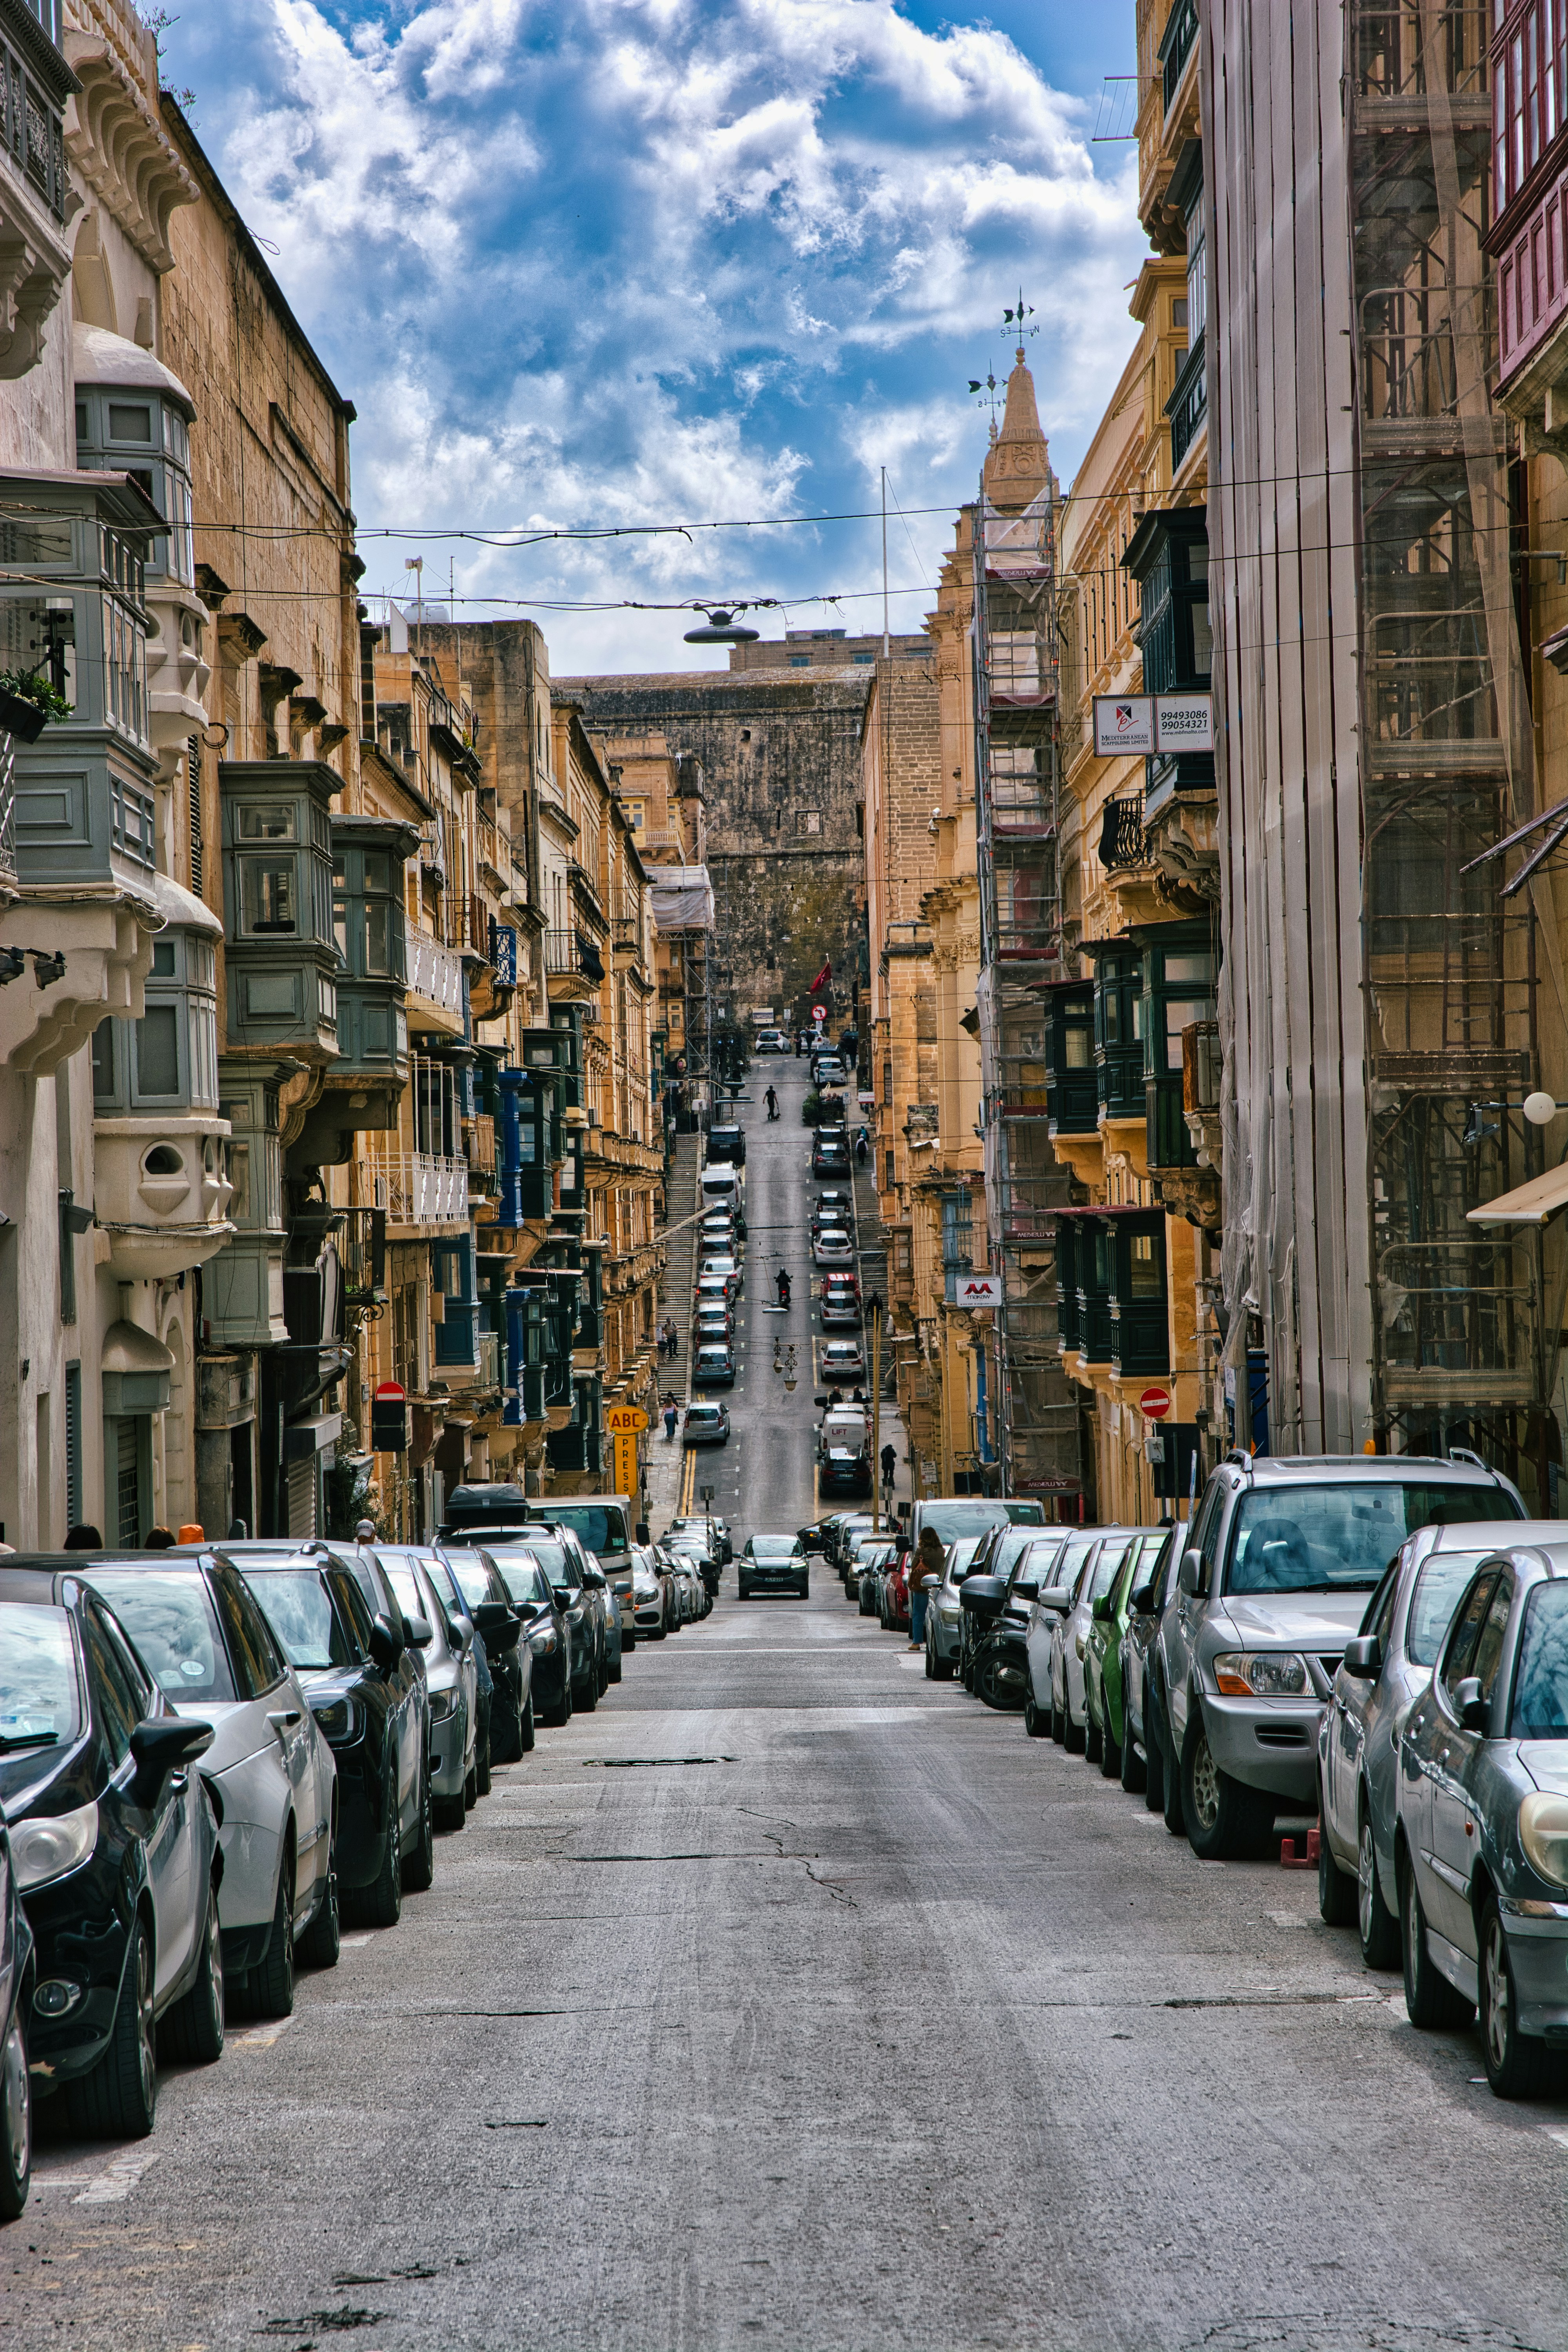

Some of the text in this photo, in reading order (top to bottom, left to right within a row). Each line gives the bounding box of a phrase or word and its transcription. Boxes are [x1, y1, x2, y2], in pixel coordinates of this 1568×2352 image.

[1161, 710, 1207, 720] 99493086
[1162, 720, 1207, 730] 99054321
[612, 1413, 640, 1428] ABC
